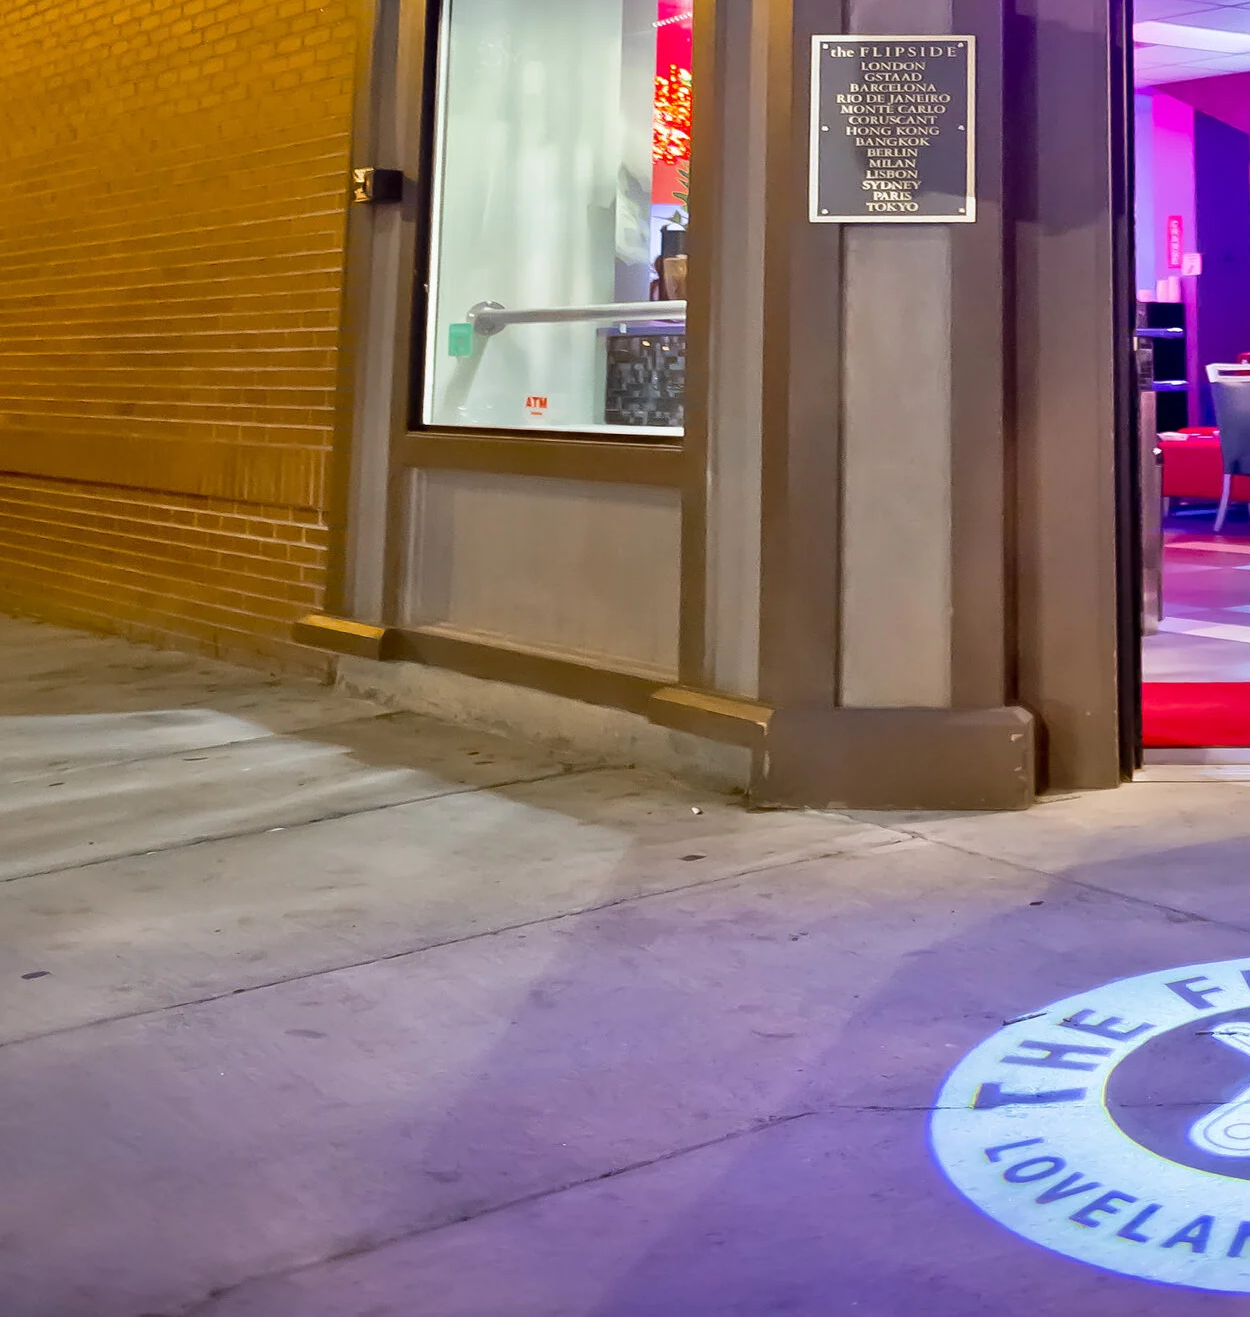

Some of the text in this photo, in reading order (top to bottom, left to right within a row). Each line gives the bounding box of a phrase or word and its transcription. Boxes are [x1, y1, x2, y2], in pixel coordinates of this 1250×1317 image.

[831, 47, 957, 58] the FLIPSIDE
[861, 62, 926, 71] LONDON
[864, 73, 922, 82] GSTAAD
[850, 84, 936, 92] BARCELONA
[836, 94, 951, 105] RIO DE JANEIRO
[840, 105, 945, 114] MONTE CARLO
[849, 116, 937, 125] CORUSCANT
[846, 127, 940, 136] HONG KONG
[856, 137, 930, 146] BANGKOK
[867, 148, 918, 157] BERLIN
[869, 159, 916, 168] MILAN
[866, 170, 918, 179] LISBON
[862, 180, 921, 190] SYDNEY
[873, 191, 912, 200] PARIS
[866, 202, 919, 212] TOKYO
[525, 396, 547, 408] ATM
[972, 1006, 1156, 1109] THE
